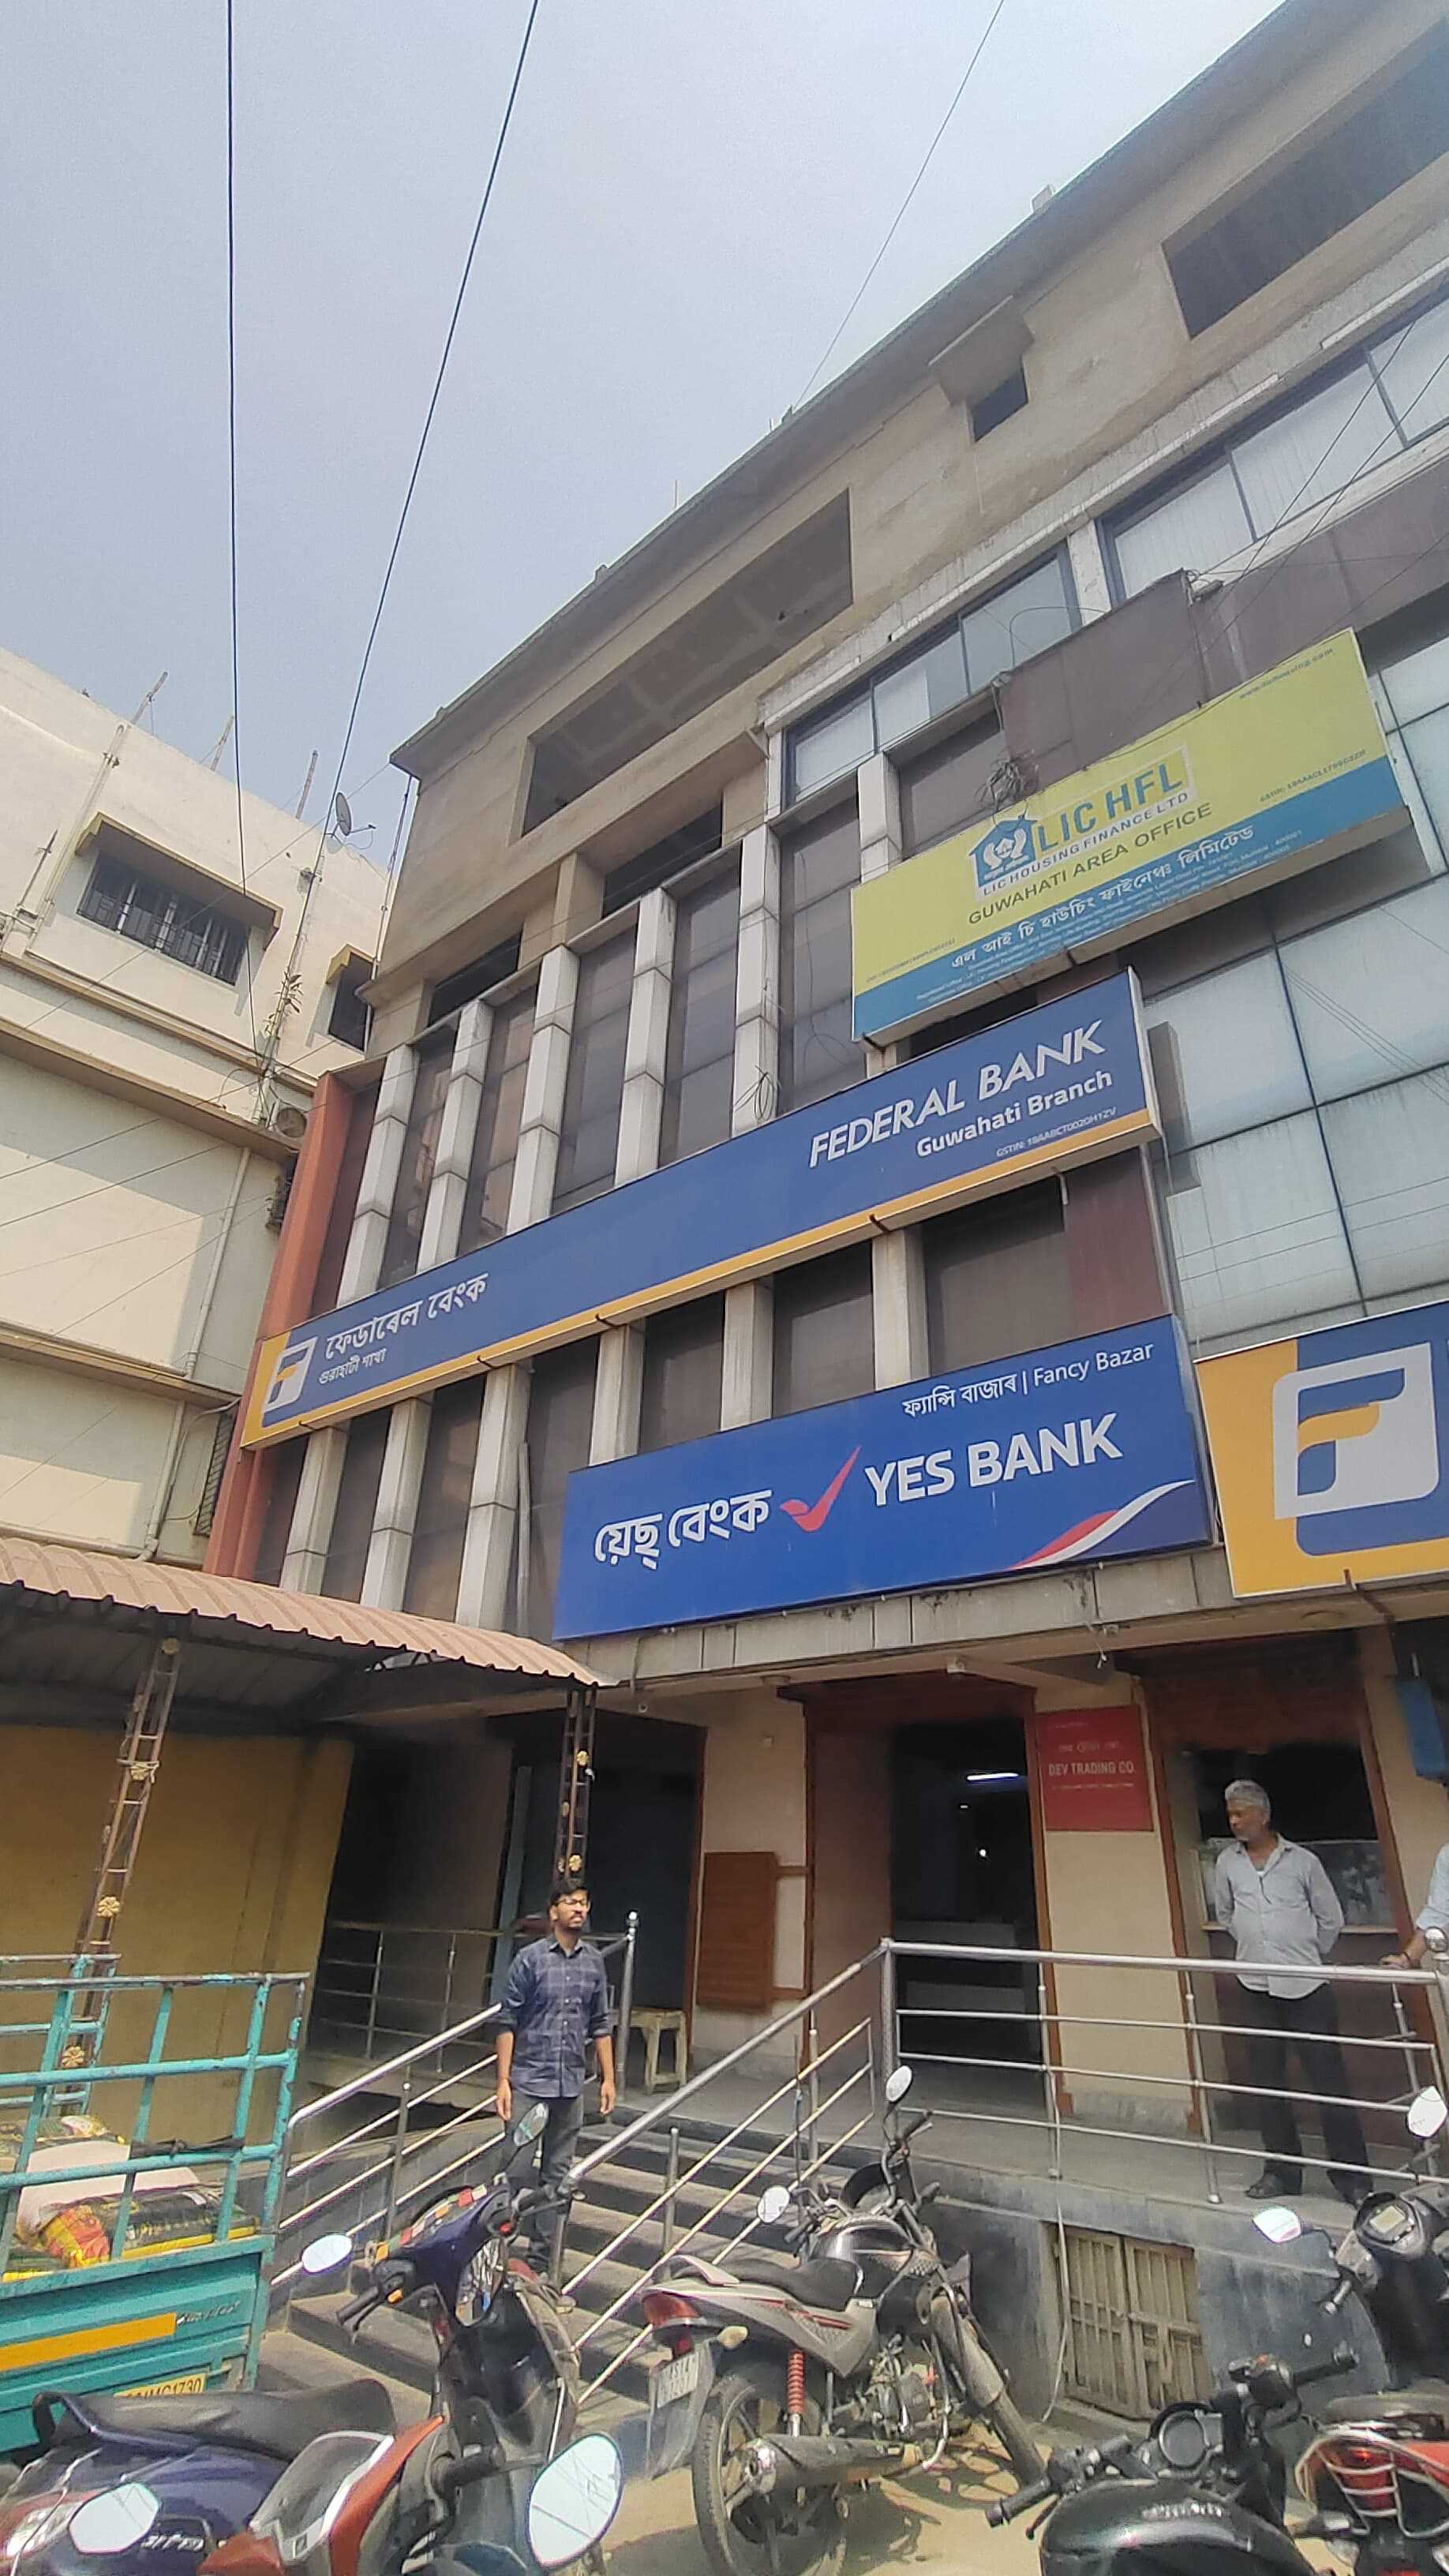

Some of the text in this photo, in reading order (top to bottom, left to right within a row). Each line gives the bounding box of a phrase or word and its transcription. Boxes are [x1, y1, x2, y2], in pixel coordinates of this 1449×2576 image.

[983, 792, 1189, 897] LIC HOUSING FINANCE LTD
[1038, 763, 1183, 852] LIC HFL
[968, 872, 1067, 925] GUWAHATI
[1073, 844, 1129, 878] AREA
[1134, 802, 1213, 847] OFFICE
[1176, 825, 1254, 869] লিমিটেড
[808, 1018, 1105, 1169] FEDERAL BANK
[915, 1069, 1113, 1159] Guwahati Branch
[427, 1271, 490, 1320] বেংক
[959, 1372, 1018, 1404] বাজাৰ
[1033, 1342, 1155, 1387] Fancy Bazar
[863, 1412, 1125, 1507] YES BANK
[668, 1489, 773, 1548] বেংক
[1048, 1763, 1069, 1777] DEV
[1070, 1761, 1117, 1775] TRADING
